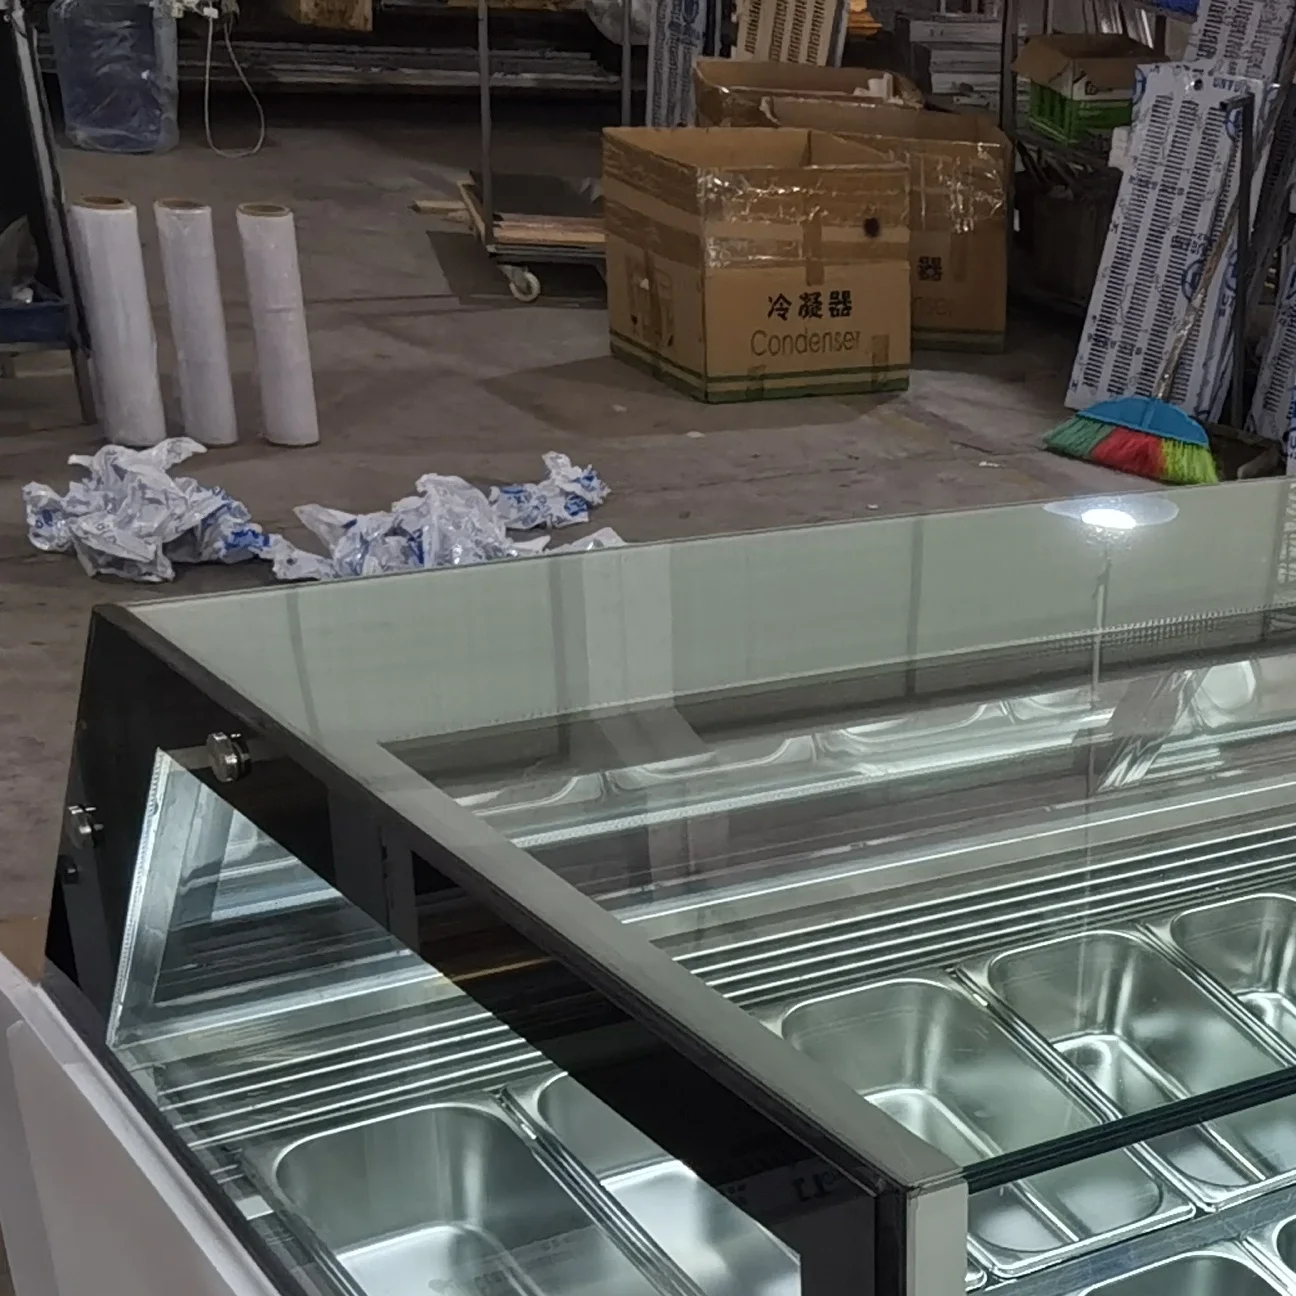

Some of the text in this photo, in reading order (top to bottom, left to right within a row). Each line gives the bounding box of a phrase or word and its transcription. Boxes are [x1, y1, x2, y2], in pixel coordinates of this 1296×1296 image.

[767, 290, 853, 320] 冷凝器
[750, 328, 861, 357] Condenser
